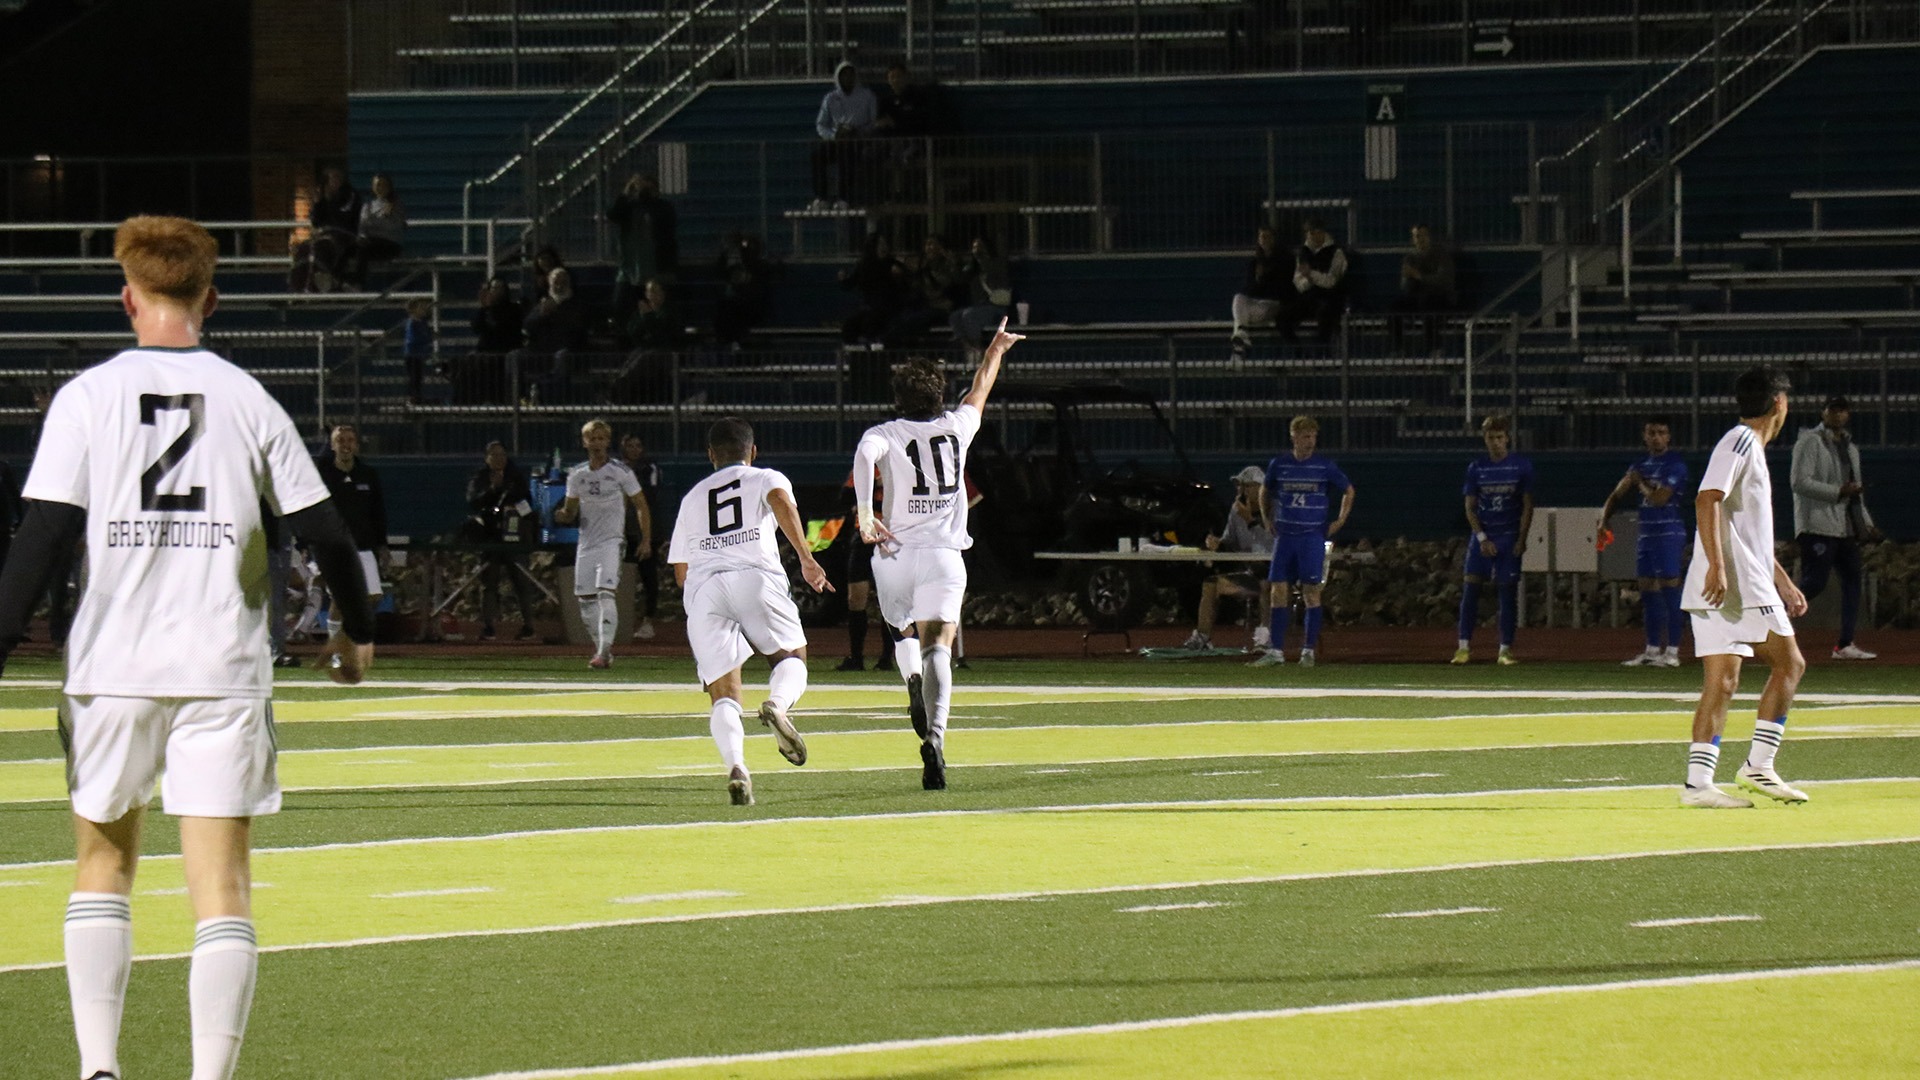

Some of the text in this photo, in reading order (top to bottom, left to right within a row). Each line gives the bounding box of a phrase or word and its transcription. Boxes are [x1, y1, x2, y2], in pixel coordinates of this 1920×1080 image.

[1376, 96, 1395, 120] A
[140, 393, 206, 512] 2
[905, 434, 960, 496] 10
[708, 479, 743, 536] 6
[108, 520, 235, 549] GREYHOUNDS
[699, 527, 761, 551] GREYHOUNDS
